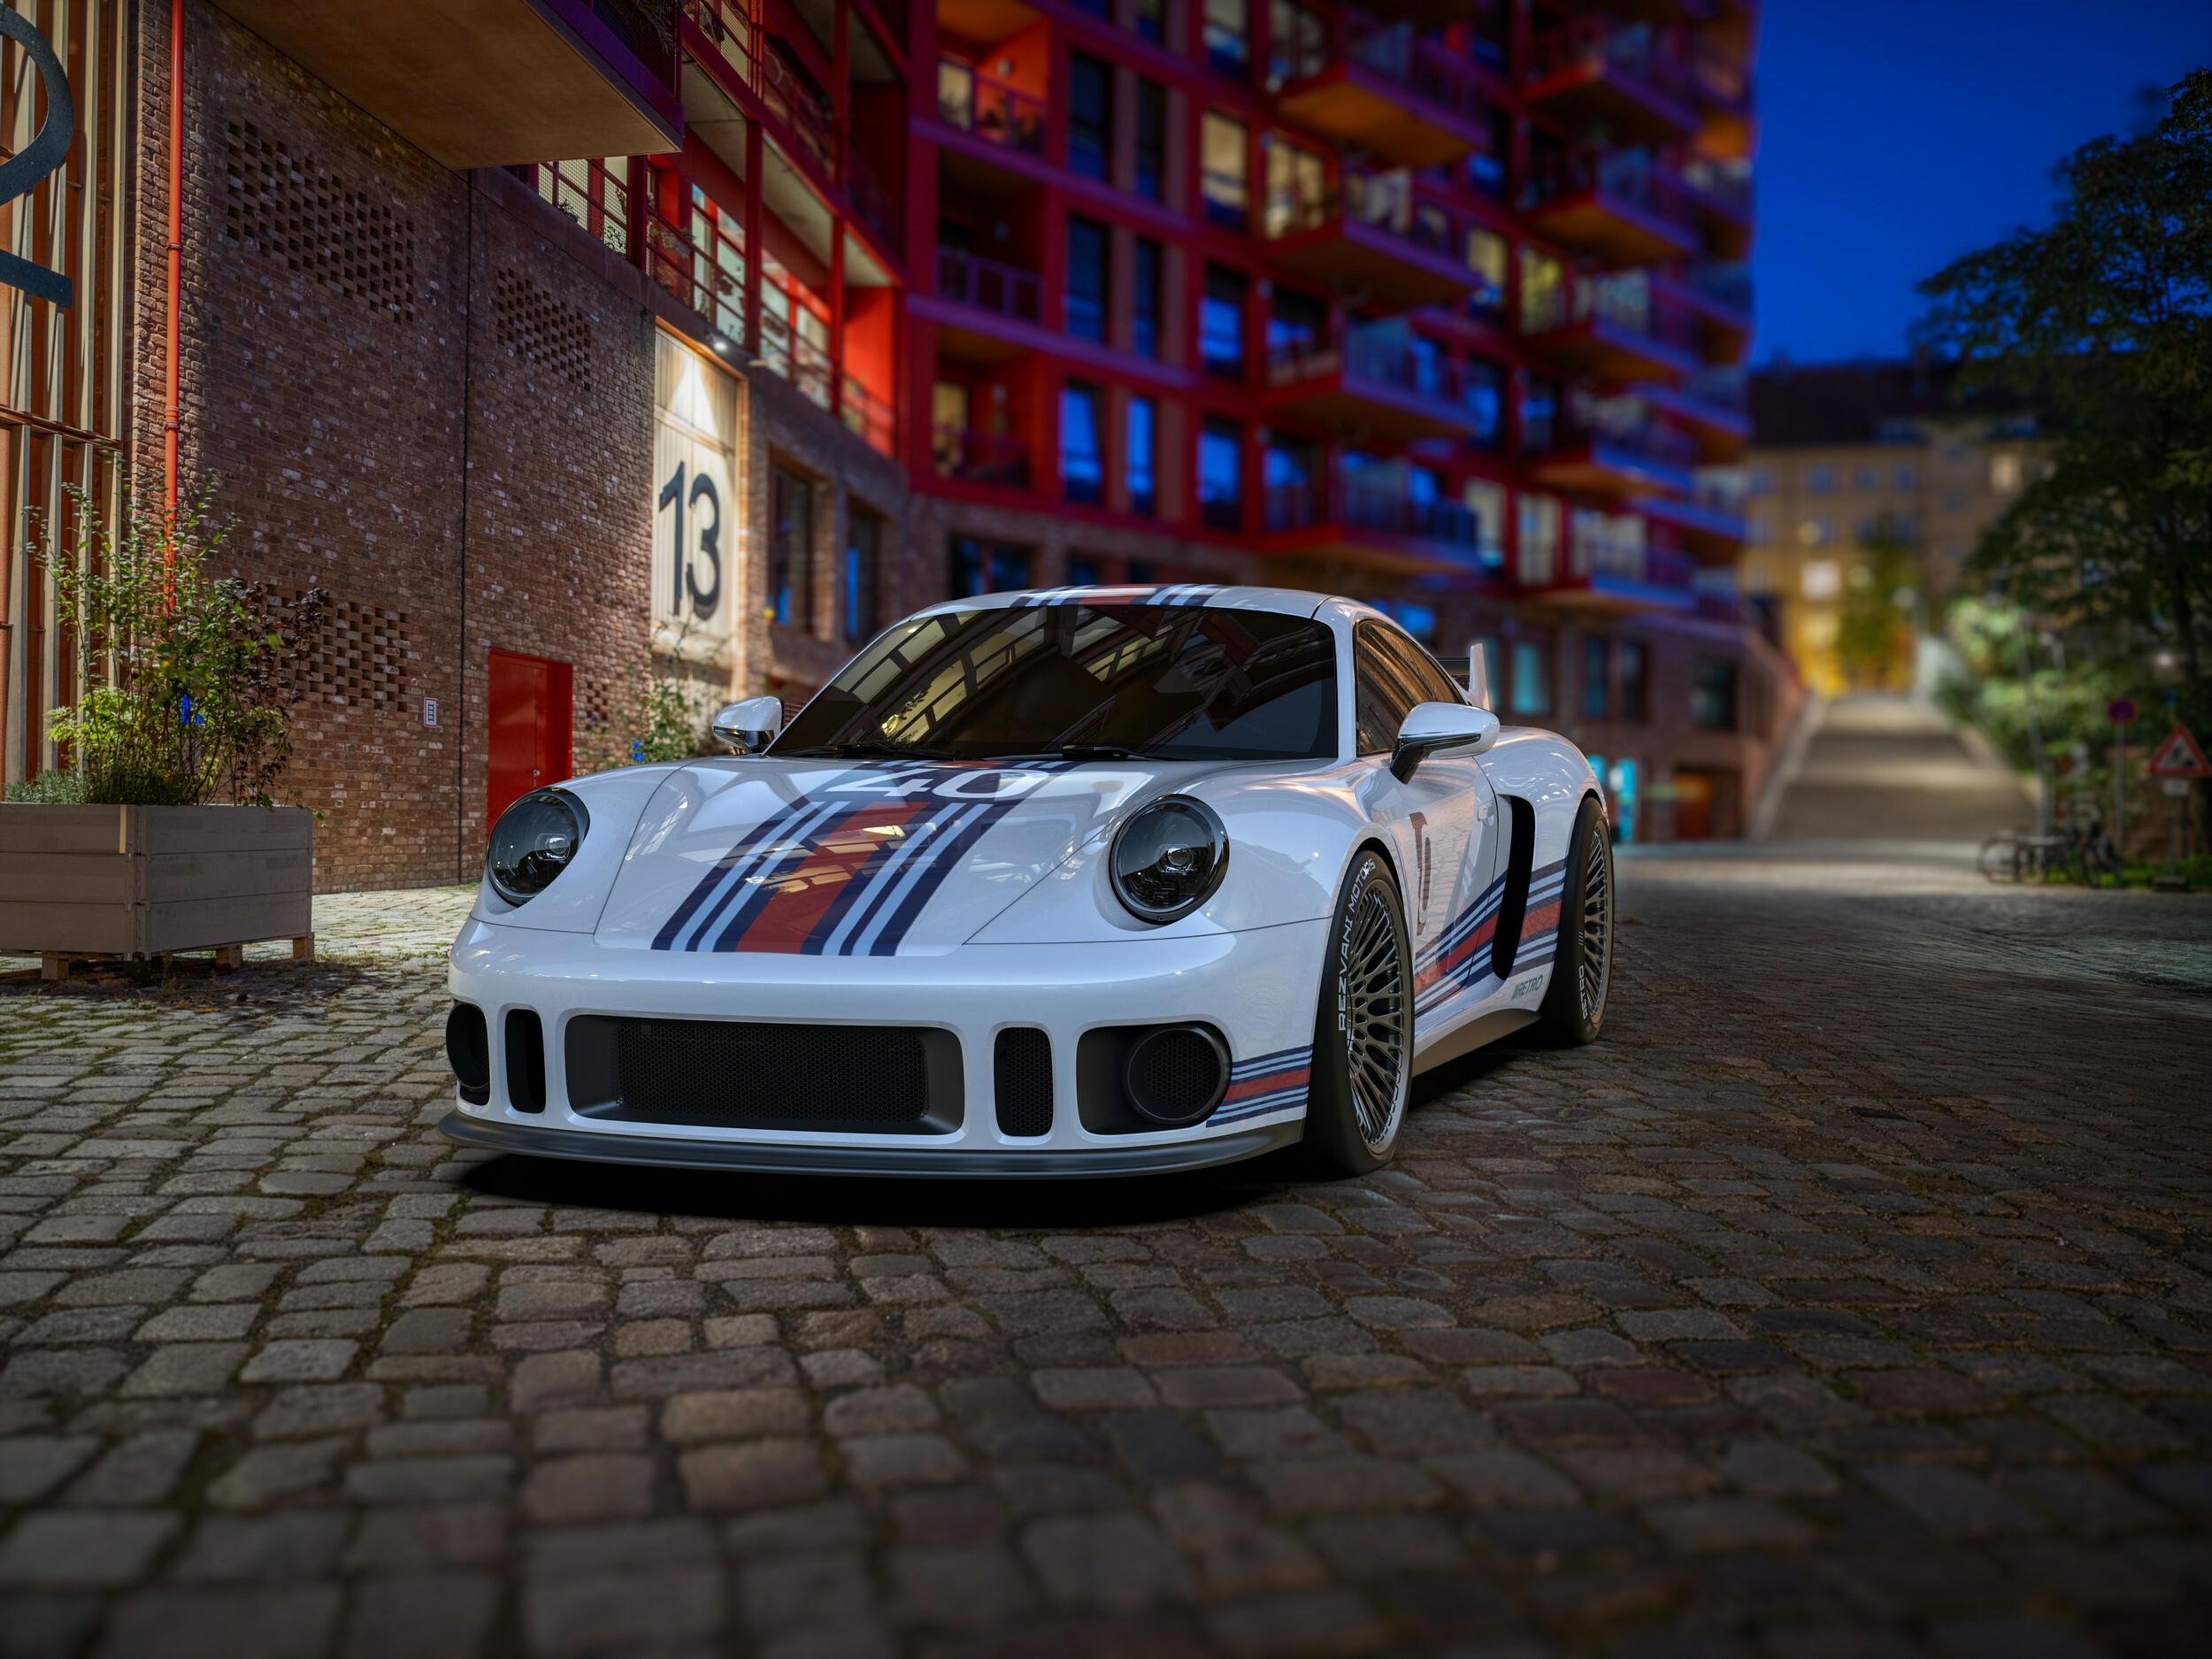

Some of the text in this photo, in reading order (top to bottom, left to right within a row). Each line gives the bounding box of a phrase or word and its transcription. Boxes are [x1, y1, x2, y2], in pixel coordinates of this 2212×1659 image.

[659, 461, 720, 620] 13
[825, 768, 1049, 798] 40
[1338, 857, 1376, 1031] REZVANI MOTORS
[1578, 965, 1588, 1020] RETRO
